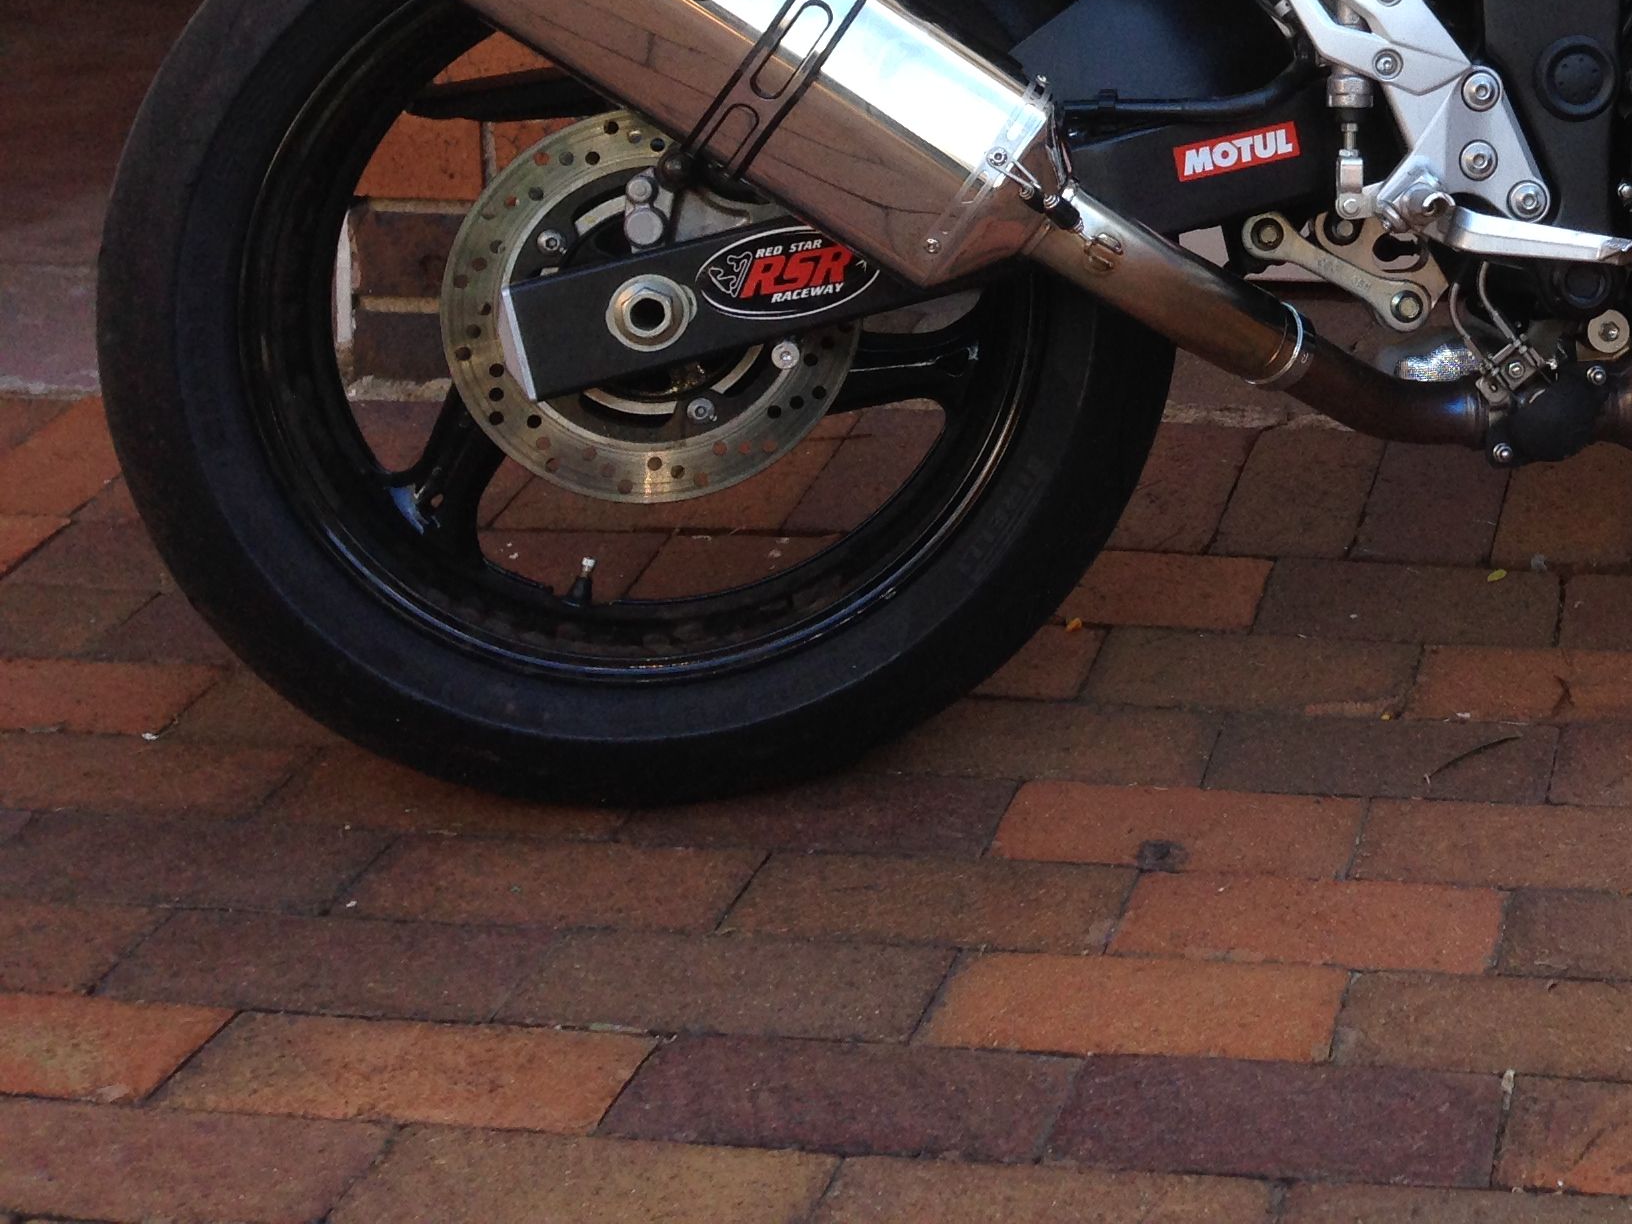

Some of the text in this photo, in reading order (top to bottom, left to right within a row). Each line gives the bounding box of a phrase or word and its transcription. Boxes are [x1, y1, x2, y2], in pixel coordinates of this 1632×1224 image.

[1183, 128, 1293, 176] MOTUL
[755, 238, 823, 259] RED STAR
[740, 245, 853, 299] RSR
[771, 282, 844, 304] RACEWAY
